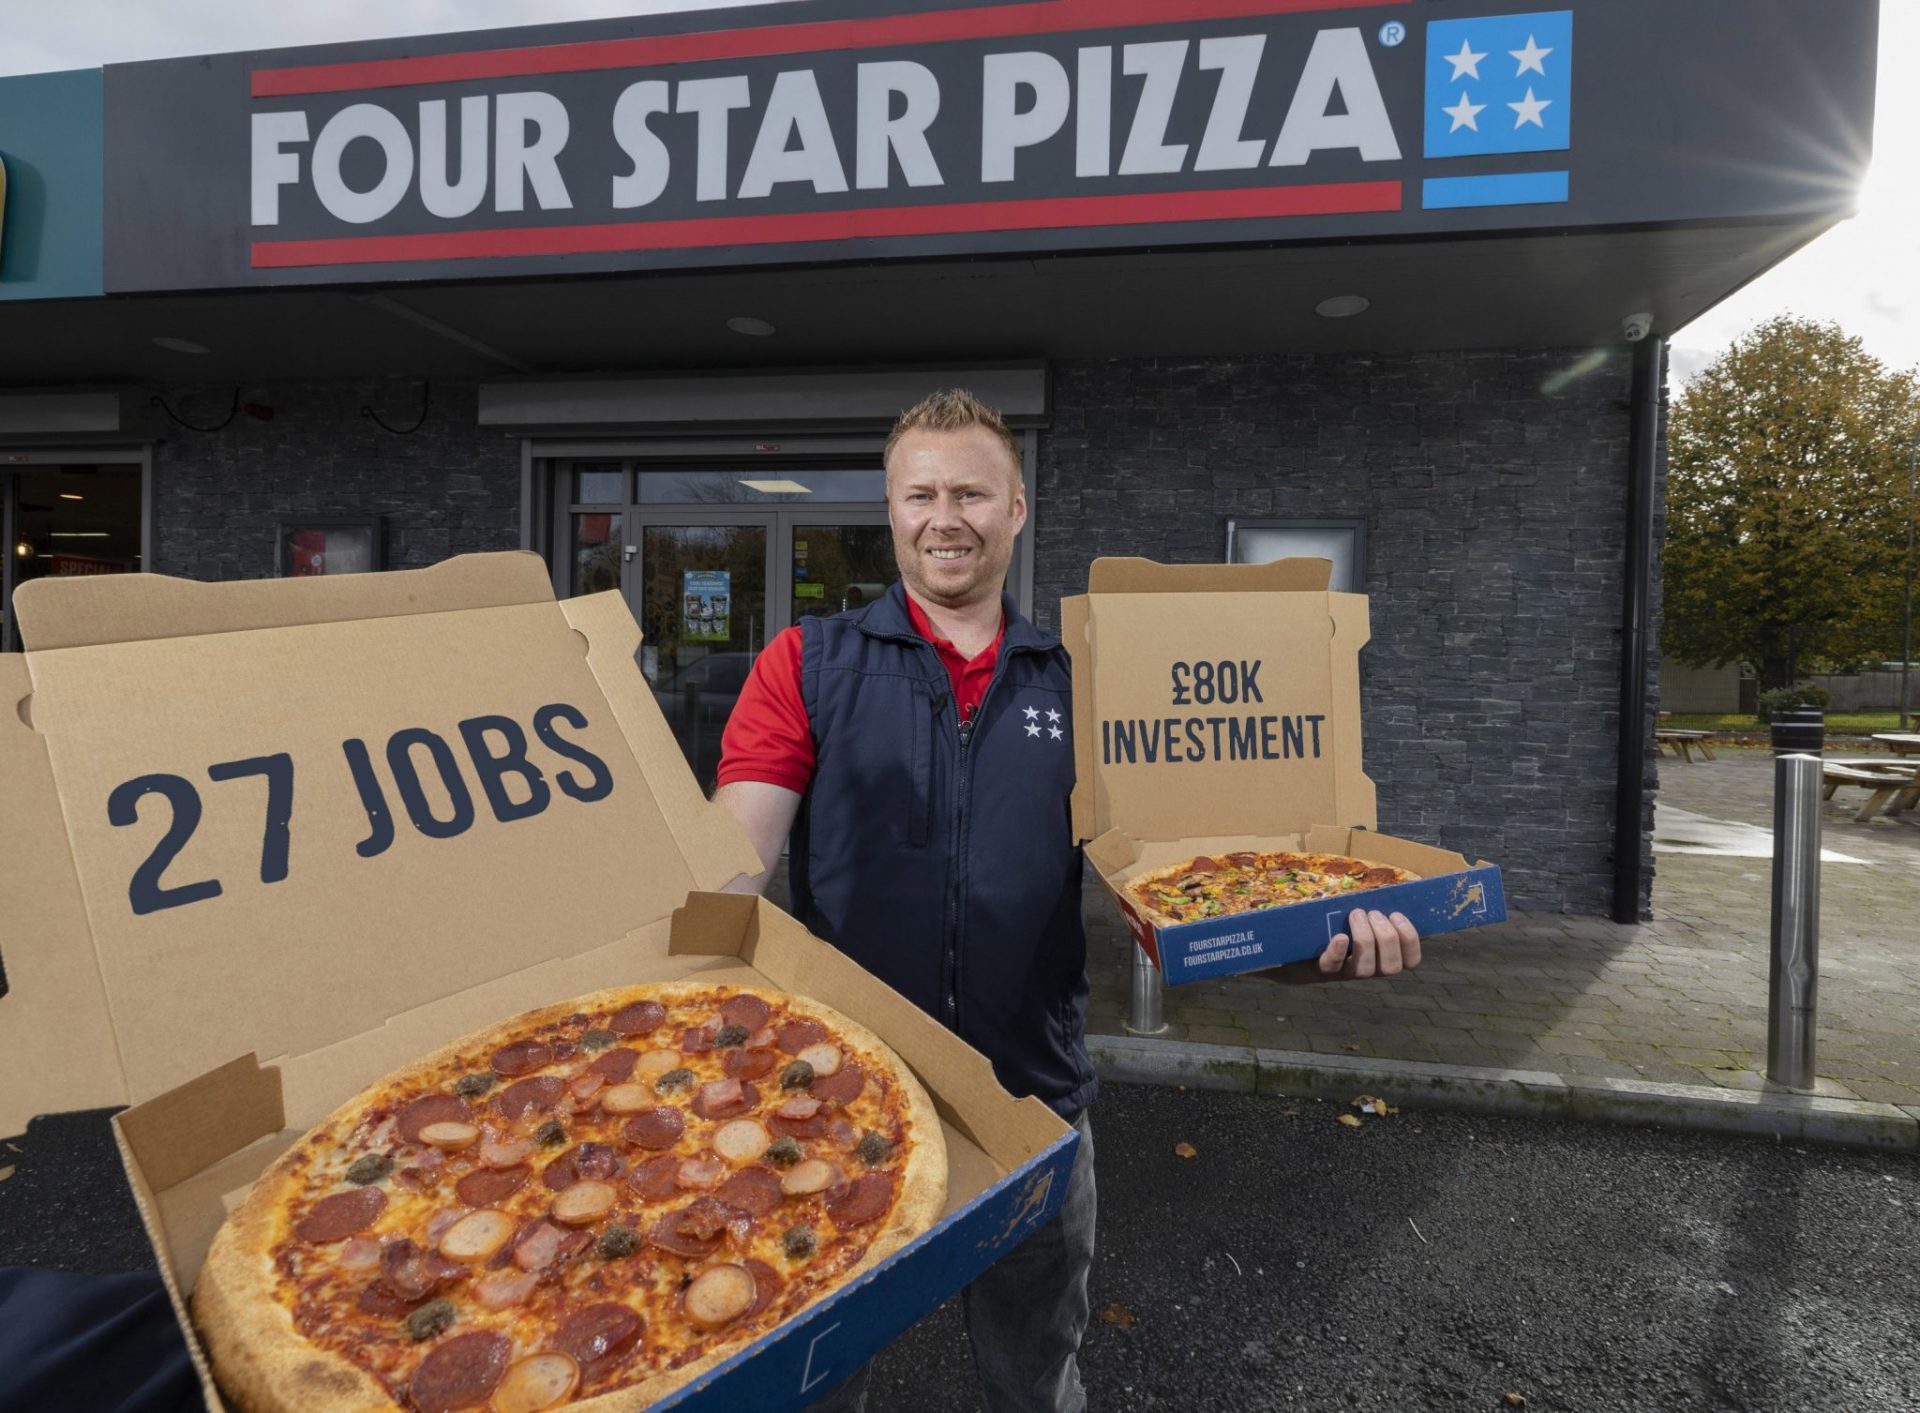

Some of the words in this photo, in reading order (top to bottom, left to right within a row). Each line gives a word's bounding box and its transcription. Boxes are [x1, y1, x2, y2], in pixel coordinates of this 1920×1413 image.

[251, 91, 573, 225] FOUR
[613, 60, 944, 208] STAR
[981, 27, 1402, 182] PIZZA
[1171, 660, 1264, 705] £80K
[1102, 714, 1326, 764] INVESTMENT
[107, 752, 294, 916] 27
[341, 703, 614, 858] JOBS
[1184, 942, 1264, 968] FOURSTARPIZZA.CO.UK
[1189, 931, 1255, 952] FOURSTARPIZZA.IE
